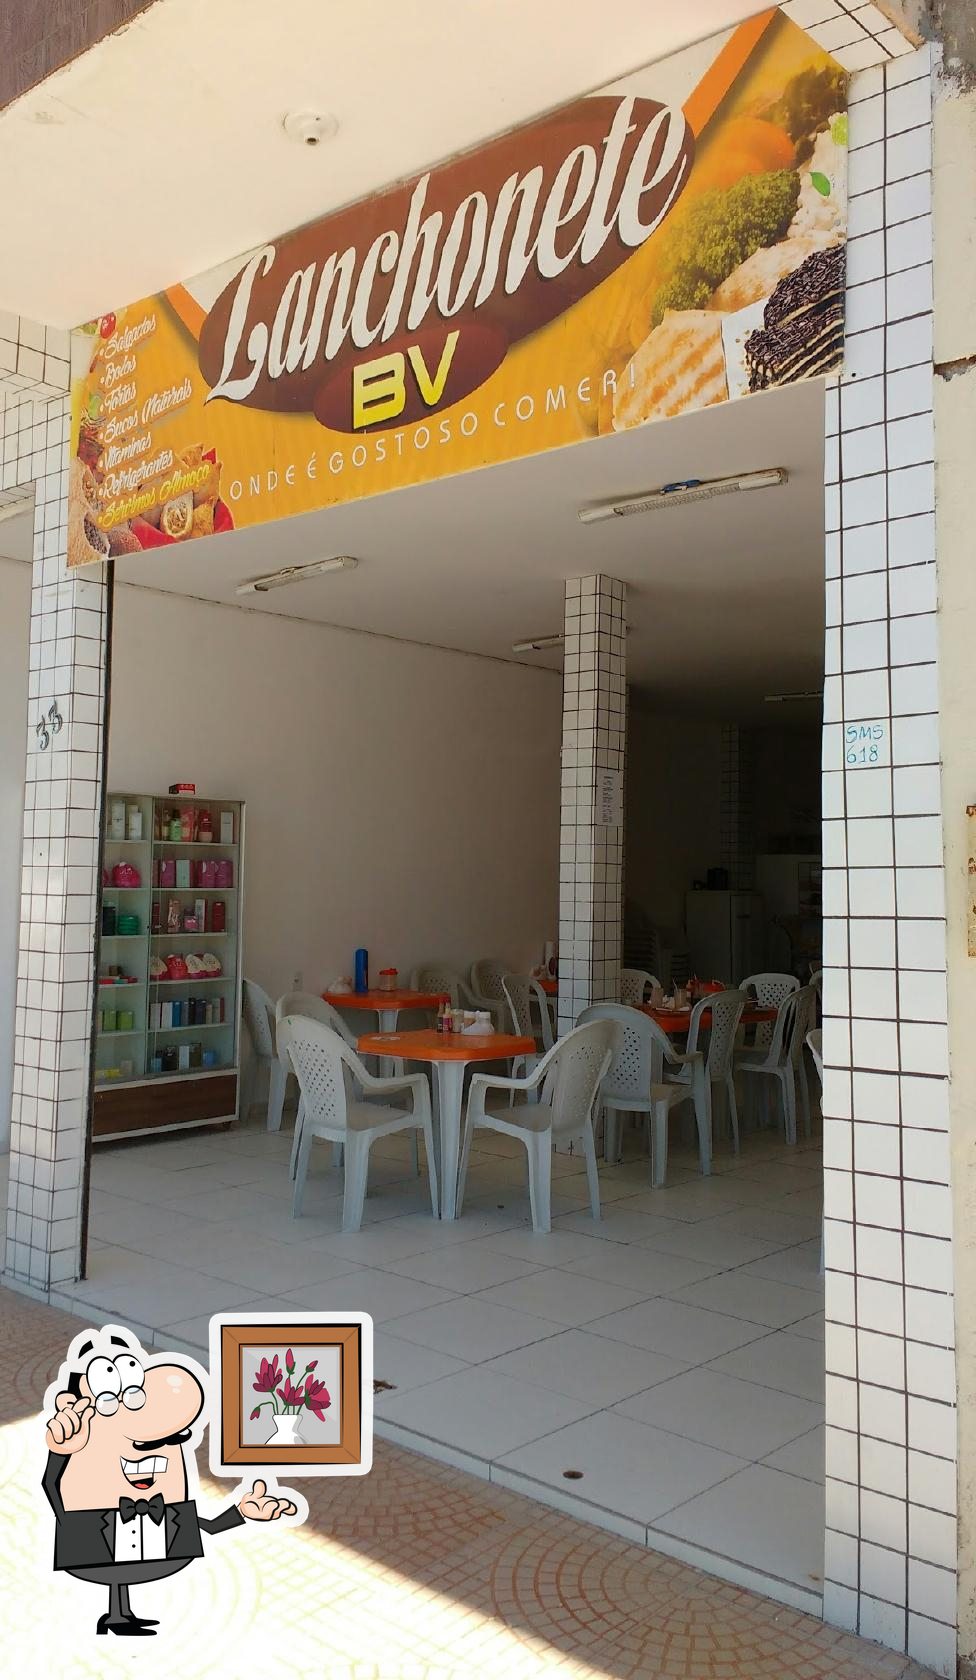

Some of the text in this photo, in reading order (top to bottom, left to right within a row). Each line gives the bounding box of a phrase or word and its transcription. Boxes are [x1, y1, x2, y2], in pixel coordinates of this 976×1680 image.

[205, 97, 687, 402] Lanchonete
[104, 314, 157, 359] Salgados
[104, 381, 137, 414] Tortas
[353, 330, 460, 430] BV
[103, 377, 193, 443] Sucos Naturais
[103, 449, 174, 499] Refrigerantes
[104, 431, 152, 471] Vitaminas
[229, 465, 296, 500] ONDE
[306, 452, 317, 478] É
[328, 412, 478, 473] GOSTOSO
[101, 464, 210, 528] Servimos Almoço
[846, 725, 884, 743] SMS
[846, 744, 879, 763] 618
